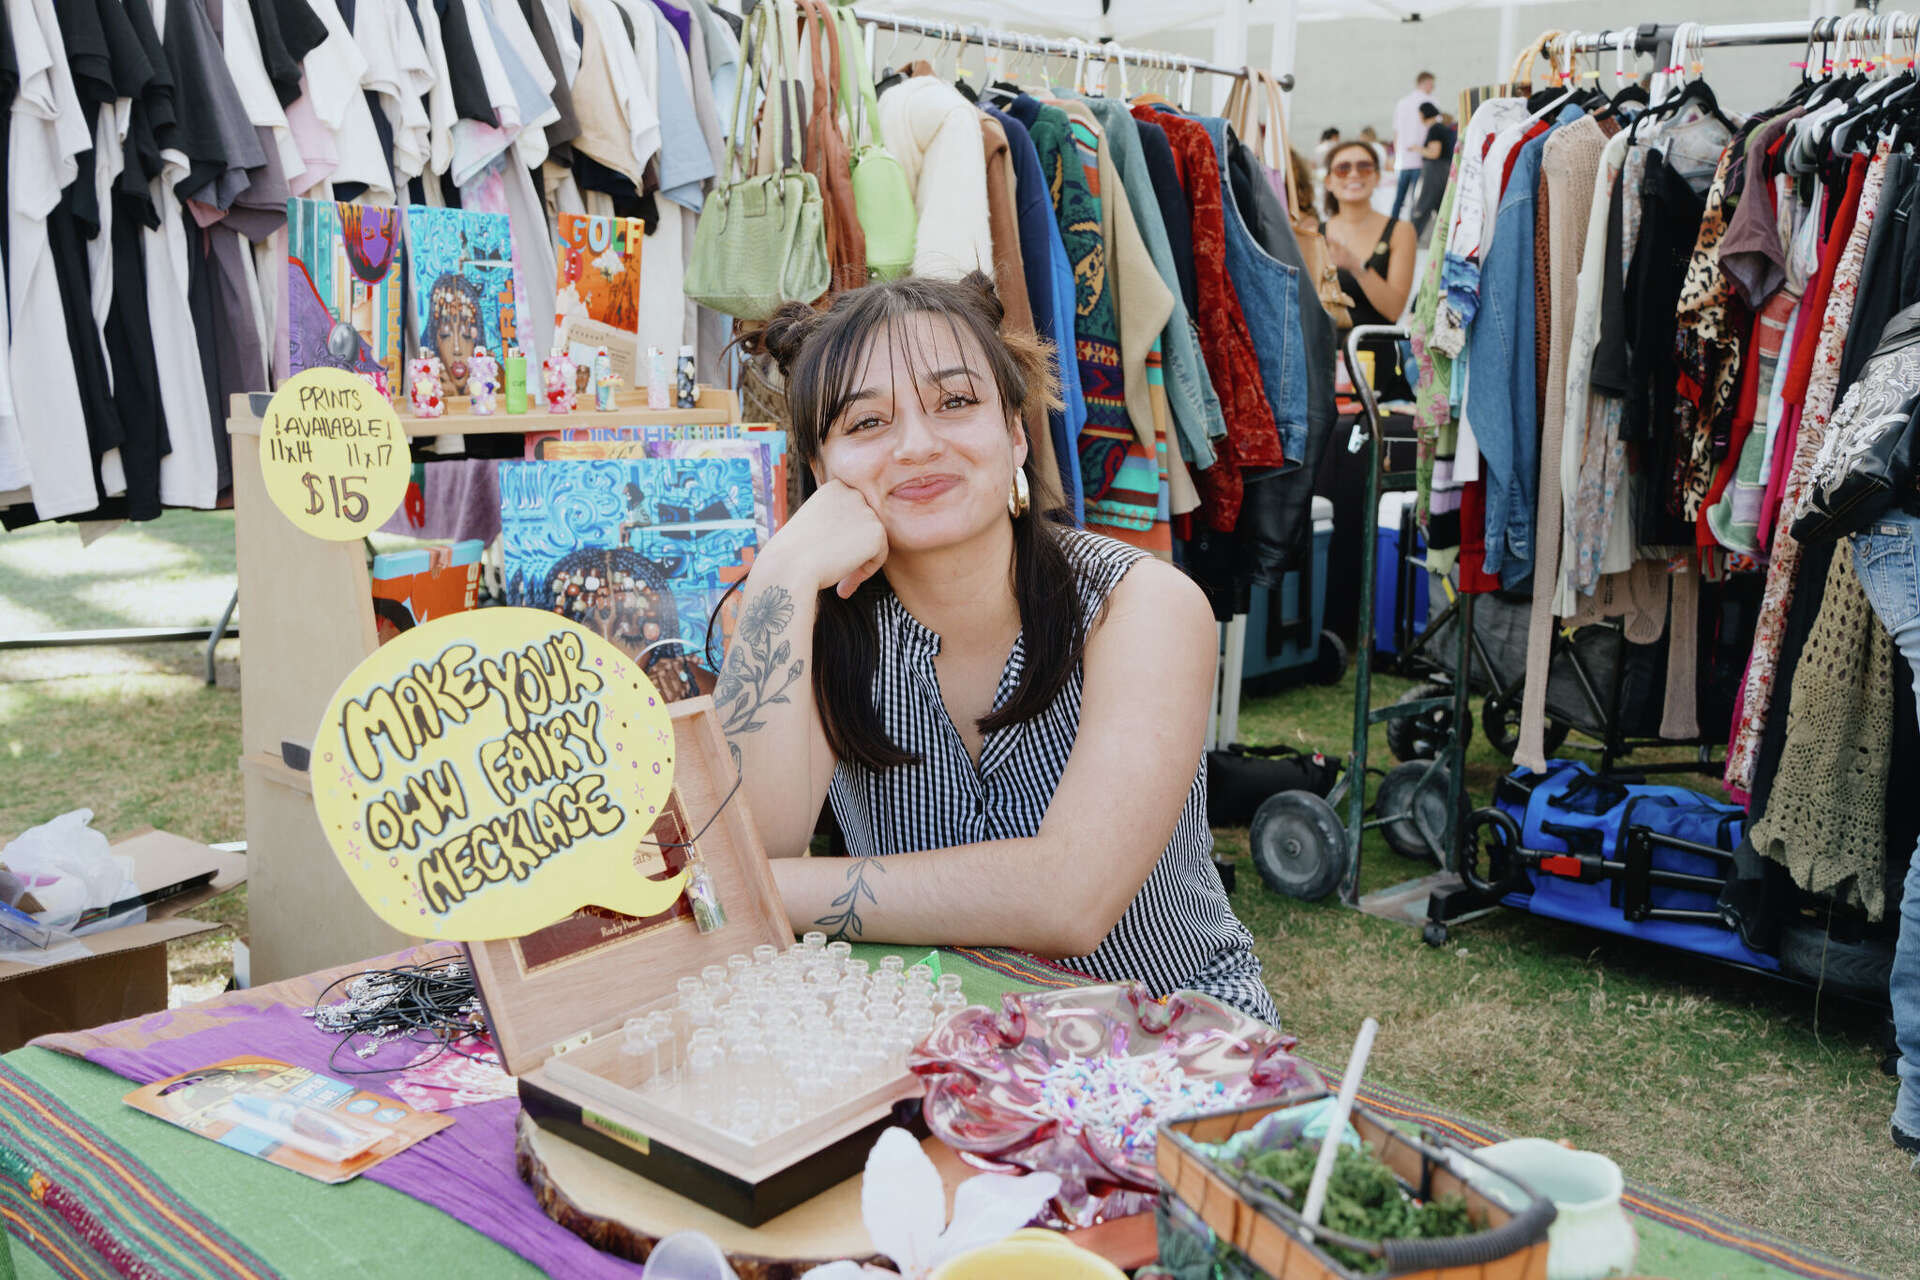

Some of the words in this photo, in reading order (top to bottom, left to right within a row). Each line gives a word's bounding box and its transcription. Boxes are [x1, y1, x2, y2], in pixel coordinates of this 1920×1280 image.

[570, 216, 643, 257] GOLF
[299, 386, 362, 412] PRINTS
[302, 472, 369, 523] $15
[342, 644, 487, 782] MAKE
[480, 631, 604, 732] YOUR
[366, 760, 468, 850] OWN
[479, 701, 607, 805] FAIRY
[418, 774, 625, 914] NECKLACE
